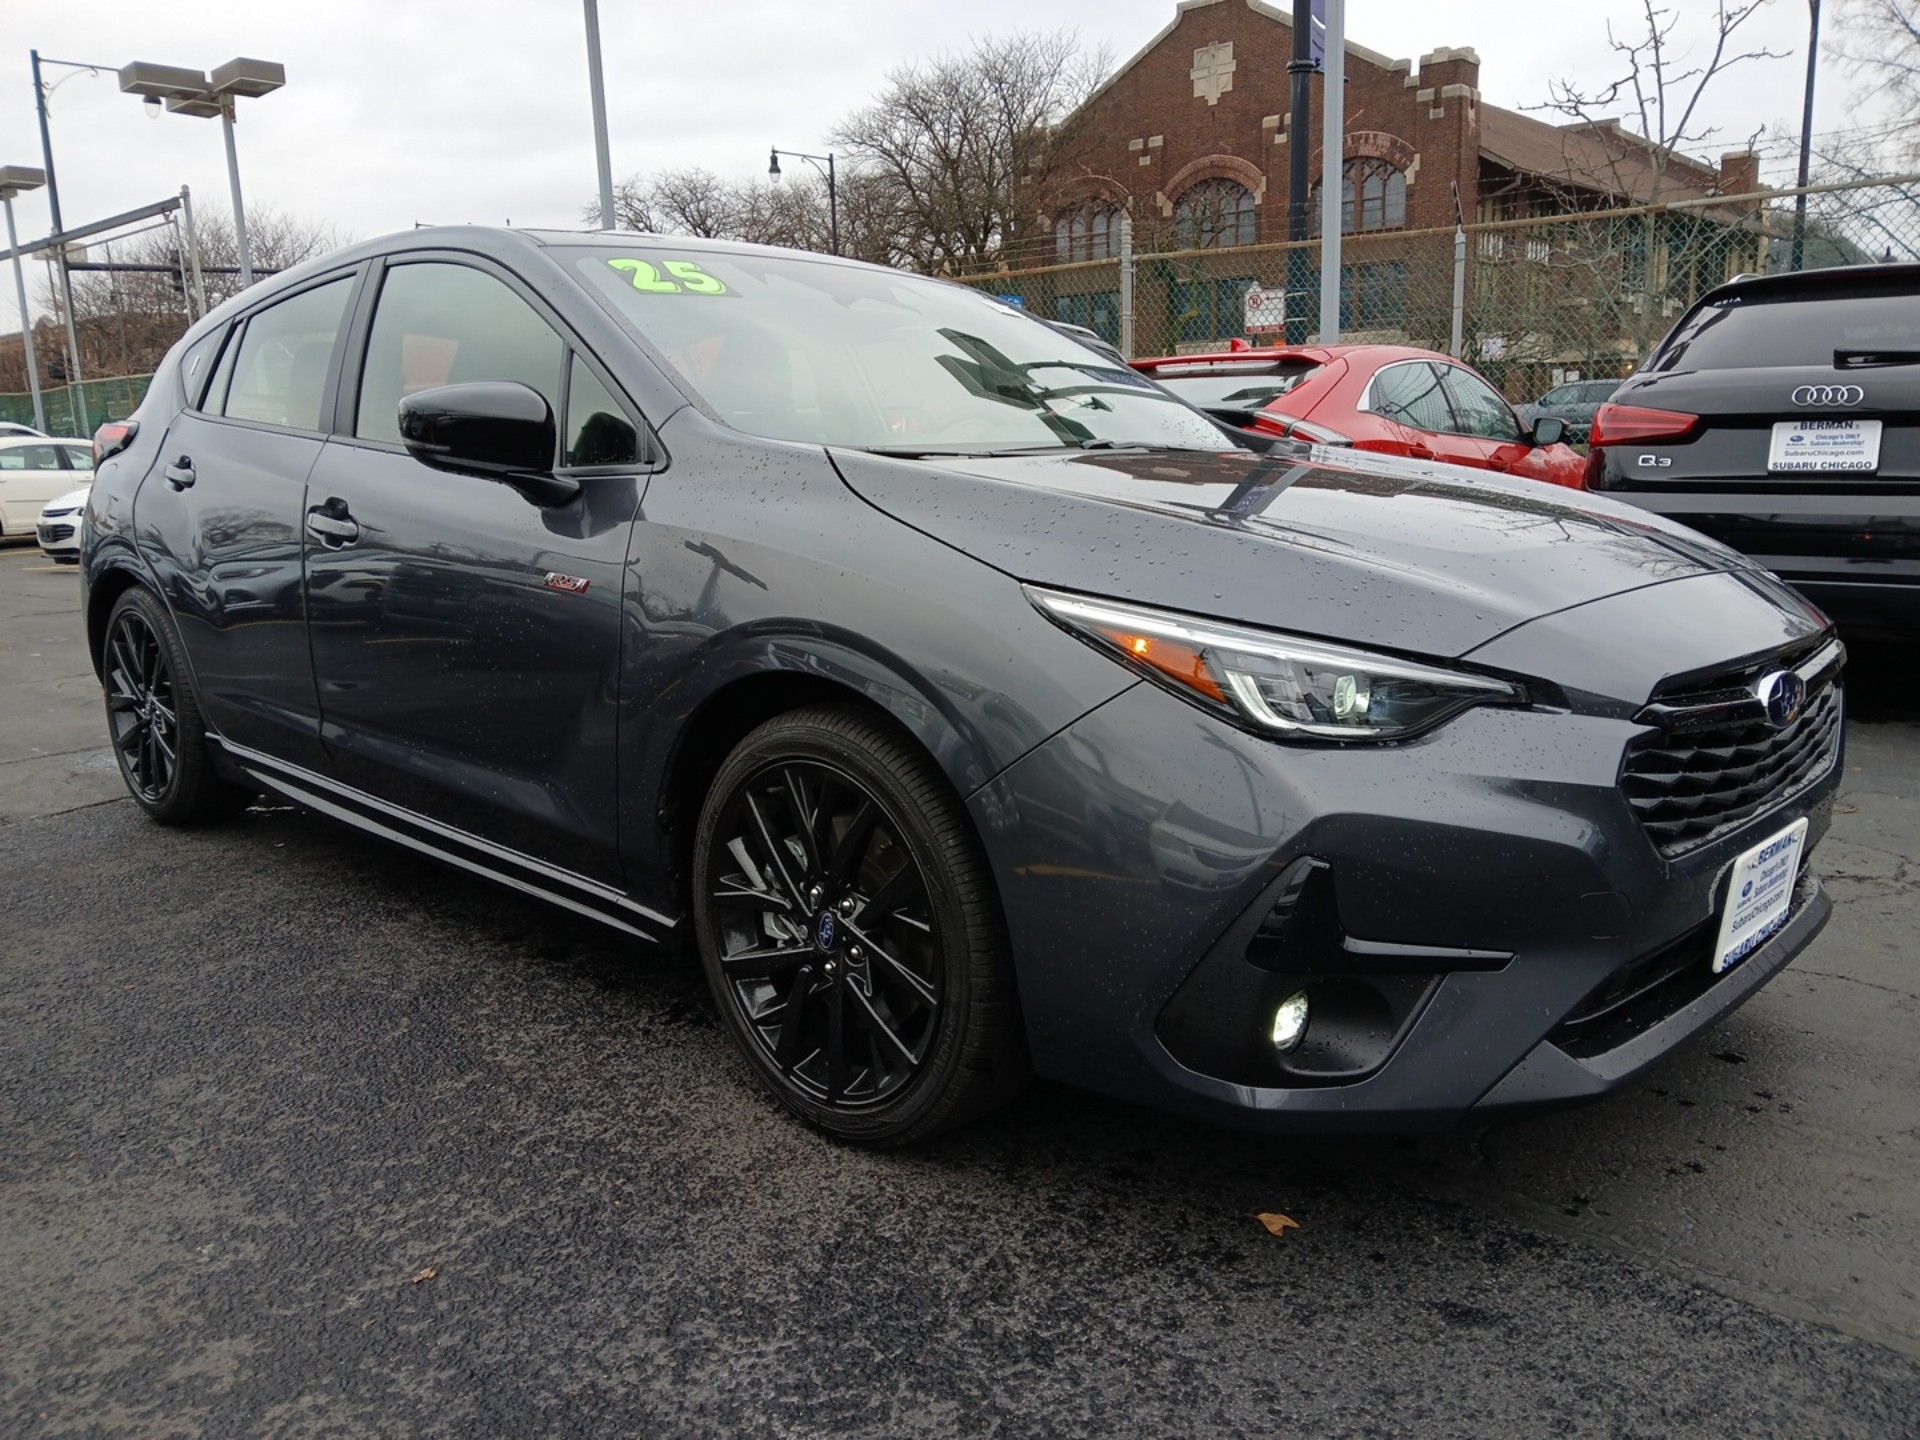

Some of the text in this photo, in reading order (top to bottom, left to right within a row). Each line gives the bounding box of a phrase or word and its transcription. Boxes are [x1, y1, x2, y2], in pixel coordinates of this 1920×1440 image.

[608, 258, 727, 296] 25
[1800, 421, 1853, 431] BERMAN
[1638, 454, 1672, 468] Q3
[1784, 450, 1865, 458] SubaruChicago.com
[1772, 460, 1873, 470] SUBARU CHICAGO
[1759, 832, 1793, 865] BERMAN
[1731, 888, 1785, 934] SubaruChicago.com
